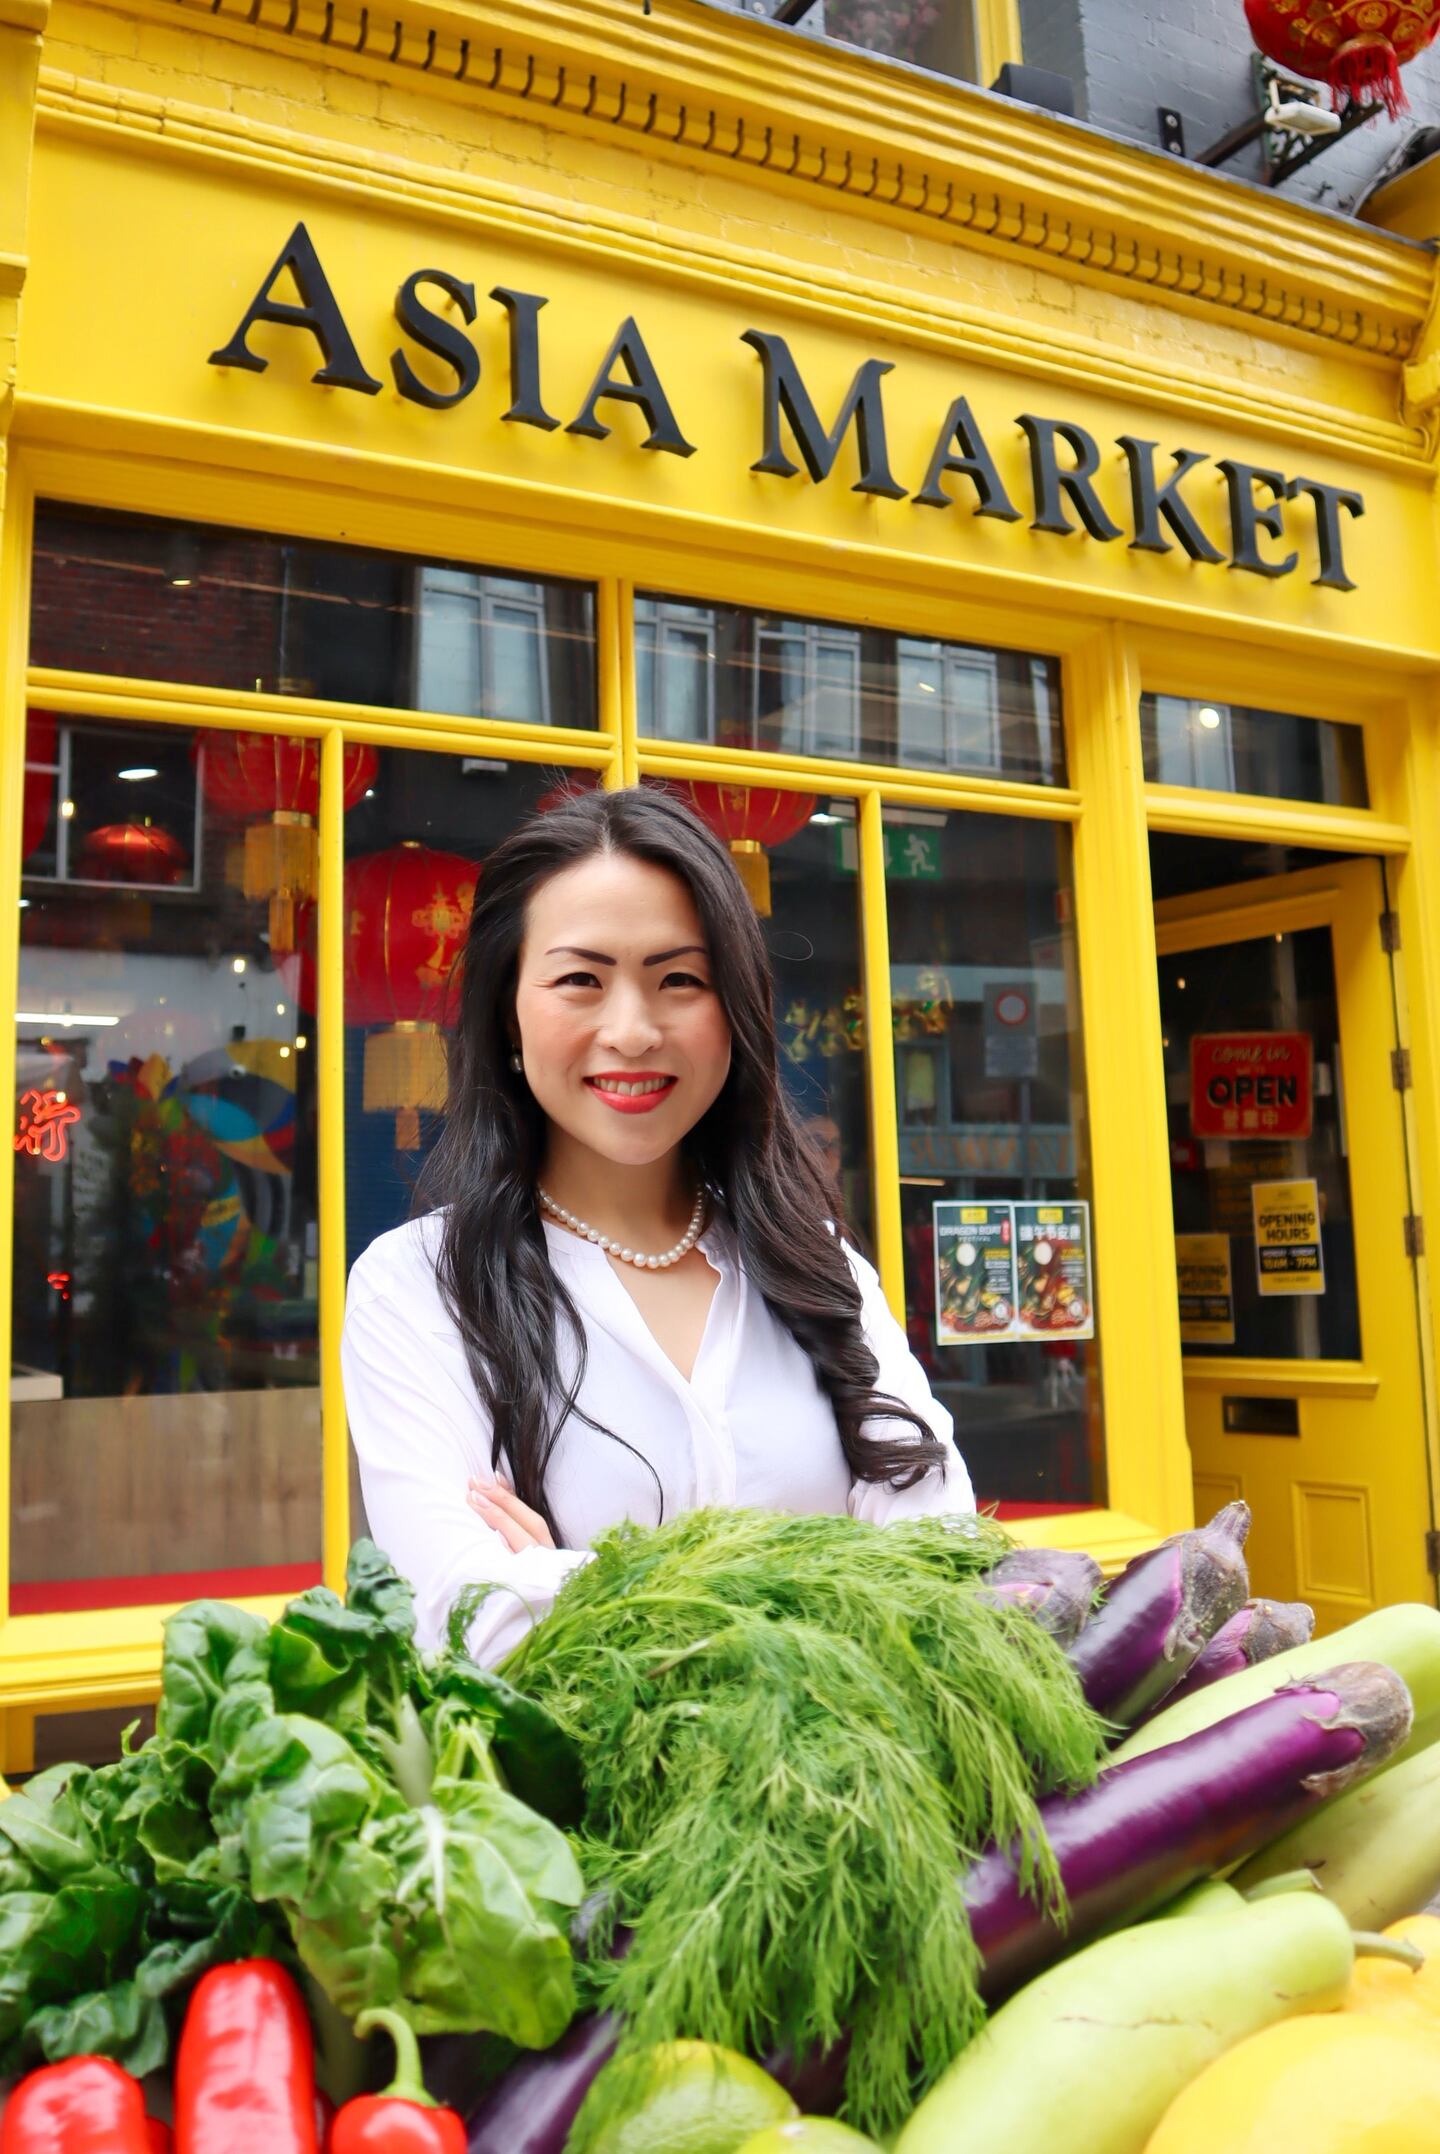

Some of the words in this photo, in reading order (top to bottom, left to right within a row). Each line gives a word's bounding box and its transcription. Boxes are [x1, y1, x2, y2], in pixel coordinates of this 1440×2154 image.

[208, 221, 698, 459] ASIA
[740, 328, 1365, 592] MARKET
[1207, 1075, 1297, 1108] OPEN
[1259, 1212, 1316, 1228] OPENING
[1267, 1228, 1311, 1241] HOURS
[1296, 1256, 1317, 1269] 7PM
